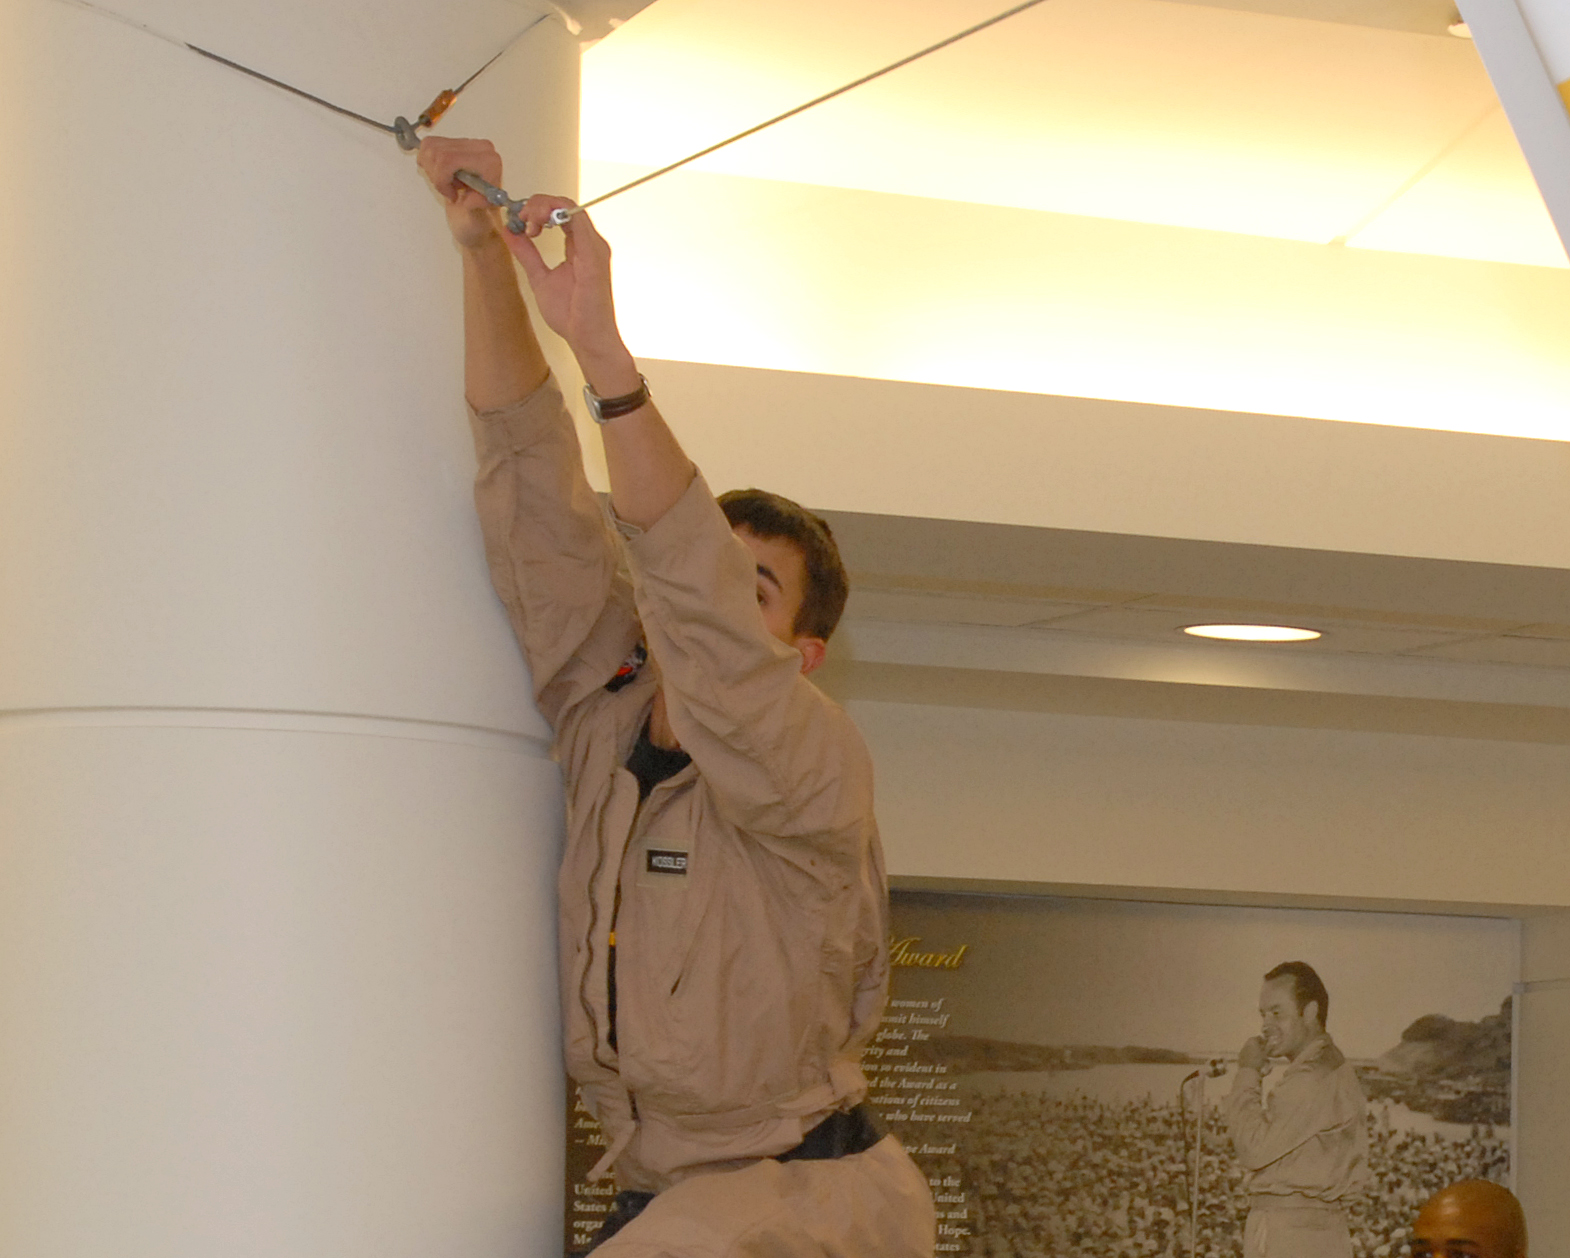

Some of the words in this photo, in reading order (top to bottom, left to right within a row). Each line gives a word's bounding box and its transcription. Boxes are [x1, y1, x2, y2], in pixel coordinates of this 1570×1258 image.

[889, 937, 967, 967] Award
[886, 1045, 909, 1056] and
[898, 1078, 935, 1089] Award
[918, 1143, 957, 1154] Award
[943, 1175, 961, 1187] the
[573, 1200, 607, 1212] States
[946, 1208, 968, 1219] and
[938, 1224, 972, 1238] Hope.
